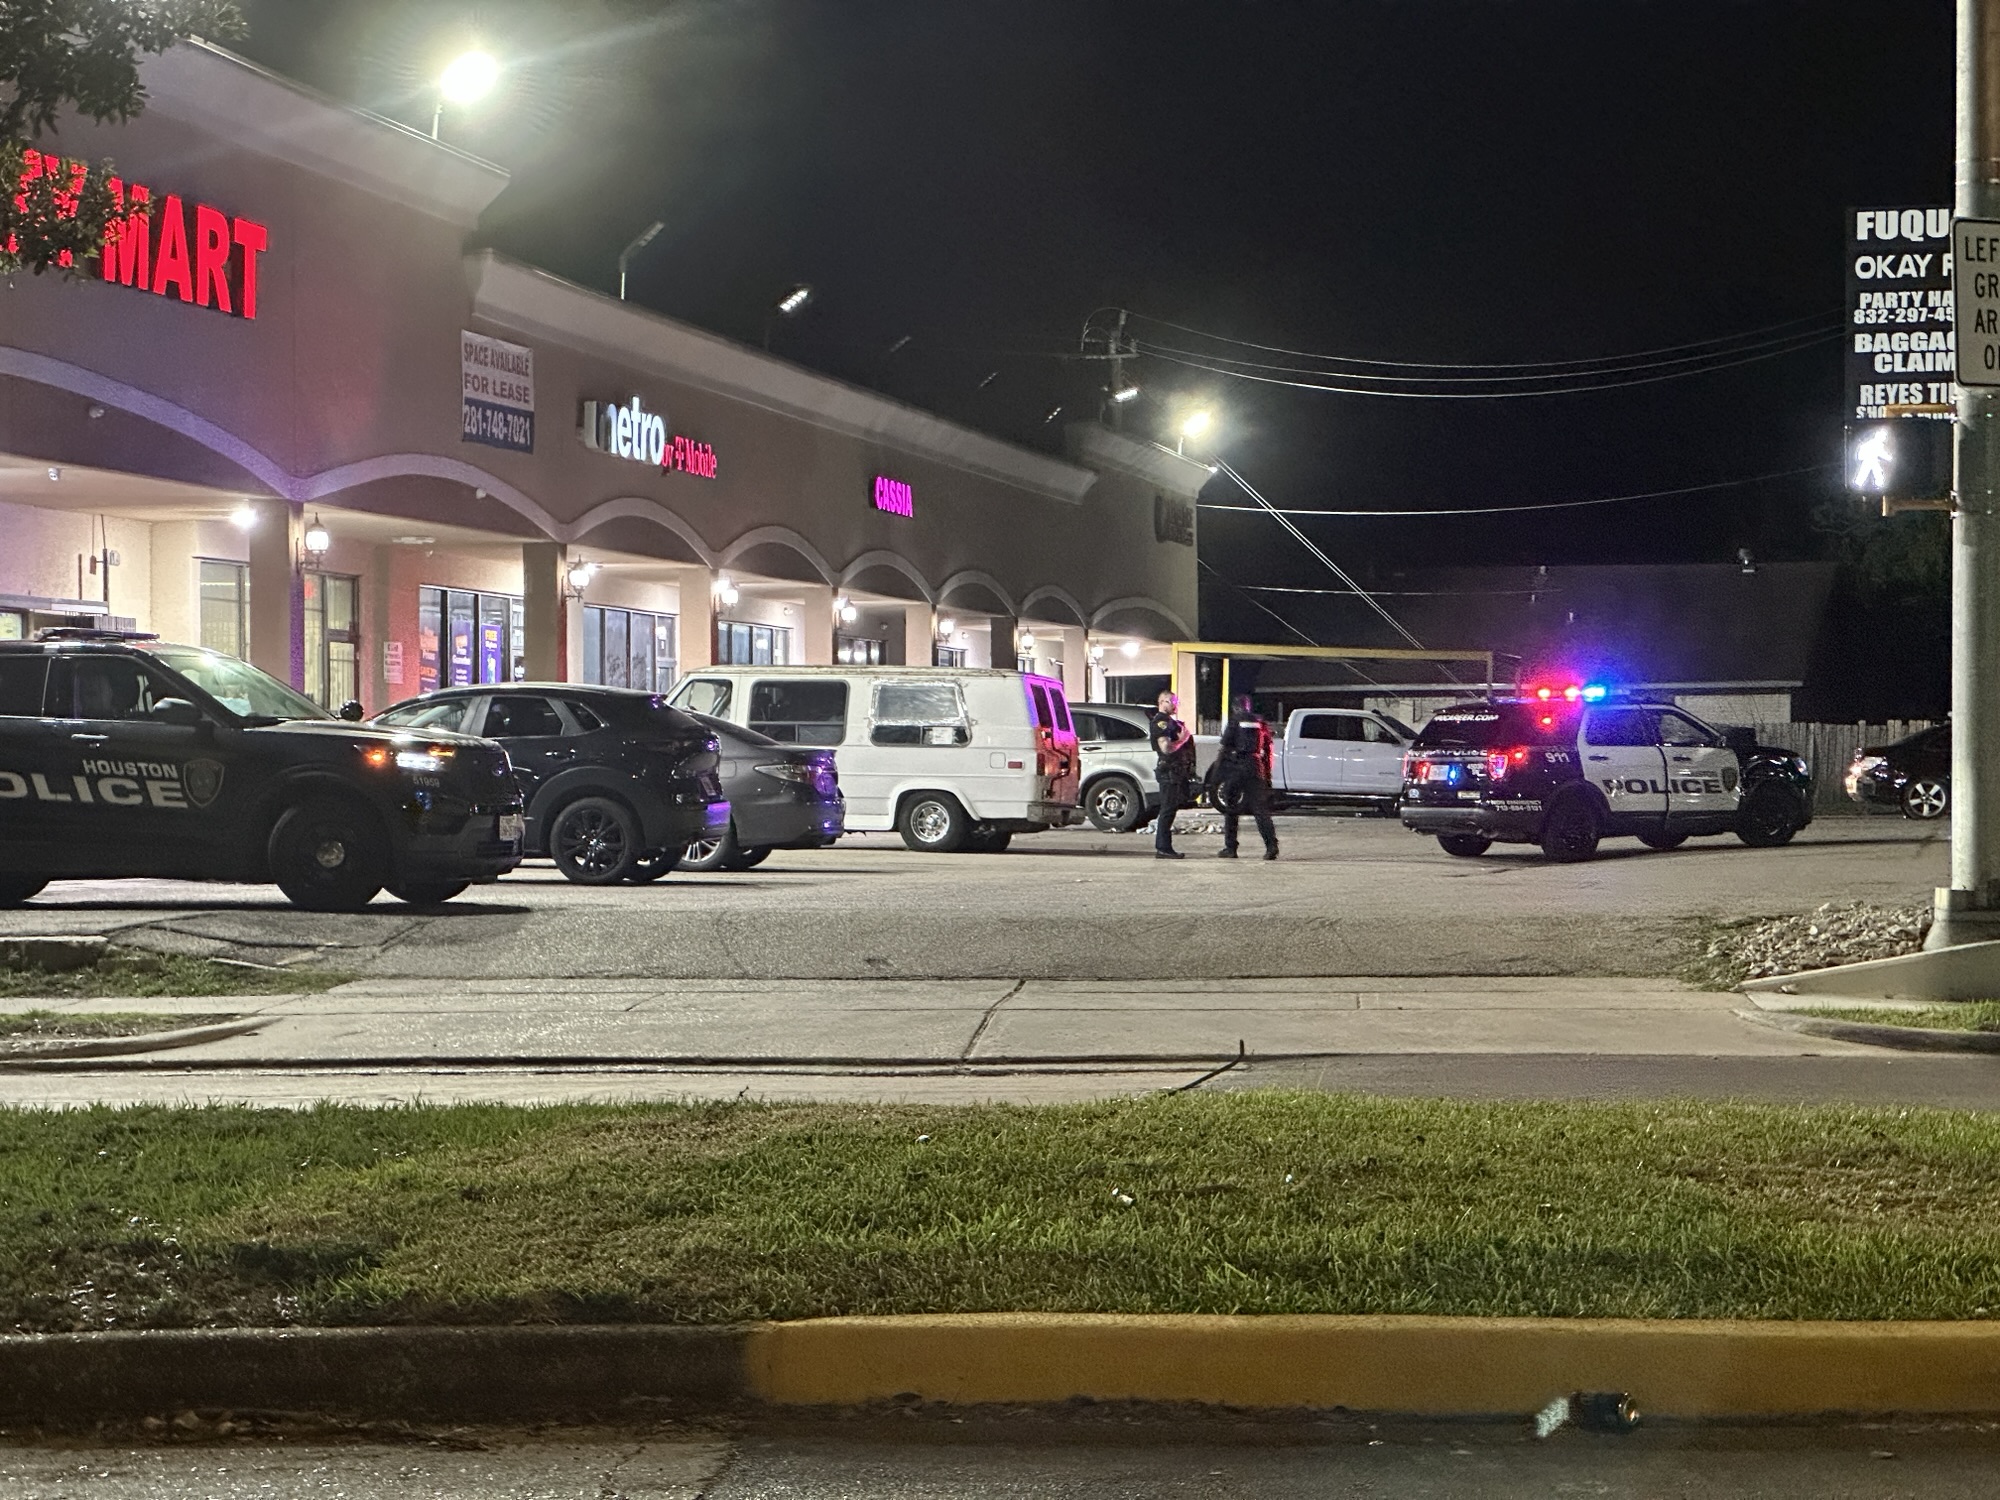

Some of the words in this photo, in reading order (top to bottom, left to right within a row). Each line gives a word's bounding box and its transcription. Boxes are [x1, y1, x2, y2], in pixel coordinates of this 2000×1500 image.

[1856, 208, 1950, 242] FUQU
[103, 177, 268, 320] MART
[1964, 236, 2000, 263] LEF
[1855, 253, 1933, 279] OKAY
[1974, 272, 1999, 298] GR
[1859, 291, 1924, 309] PARTY
[1974, 308, 1998, 335] AR
[464, 342, 489, 368] SPACE
[490, 348, 530, 377] AVAILABLE
[1874, 351, 1955, 373] CLAIM
[1983, 344, 2000, 370] O
[464, 371, 490, 395] FOR
[492, 378, 530, 404] LEASE
[1860, 383, 1923, 406] REYES
[463, 404, 531, 446] 281-748-7021
[874, 476, 913, 518] CASSIA
[82, 759, 179, 779] HOUSTON
[1544, 752, 1570, 763] 911
[0, 771, 189, 809] OLICE
[1601, 778, 1722, 794] POLICE
